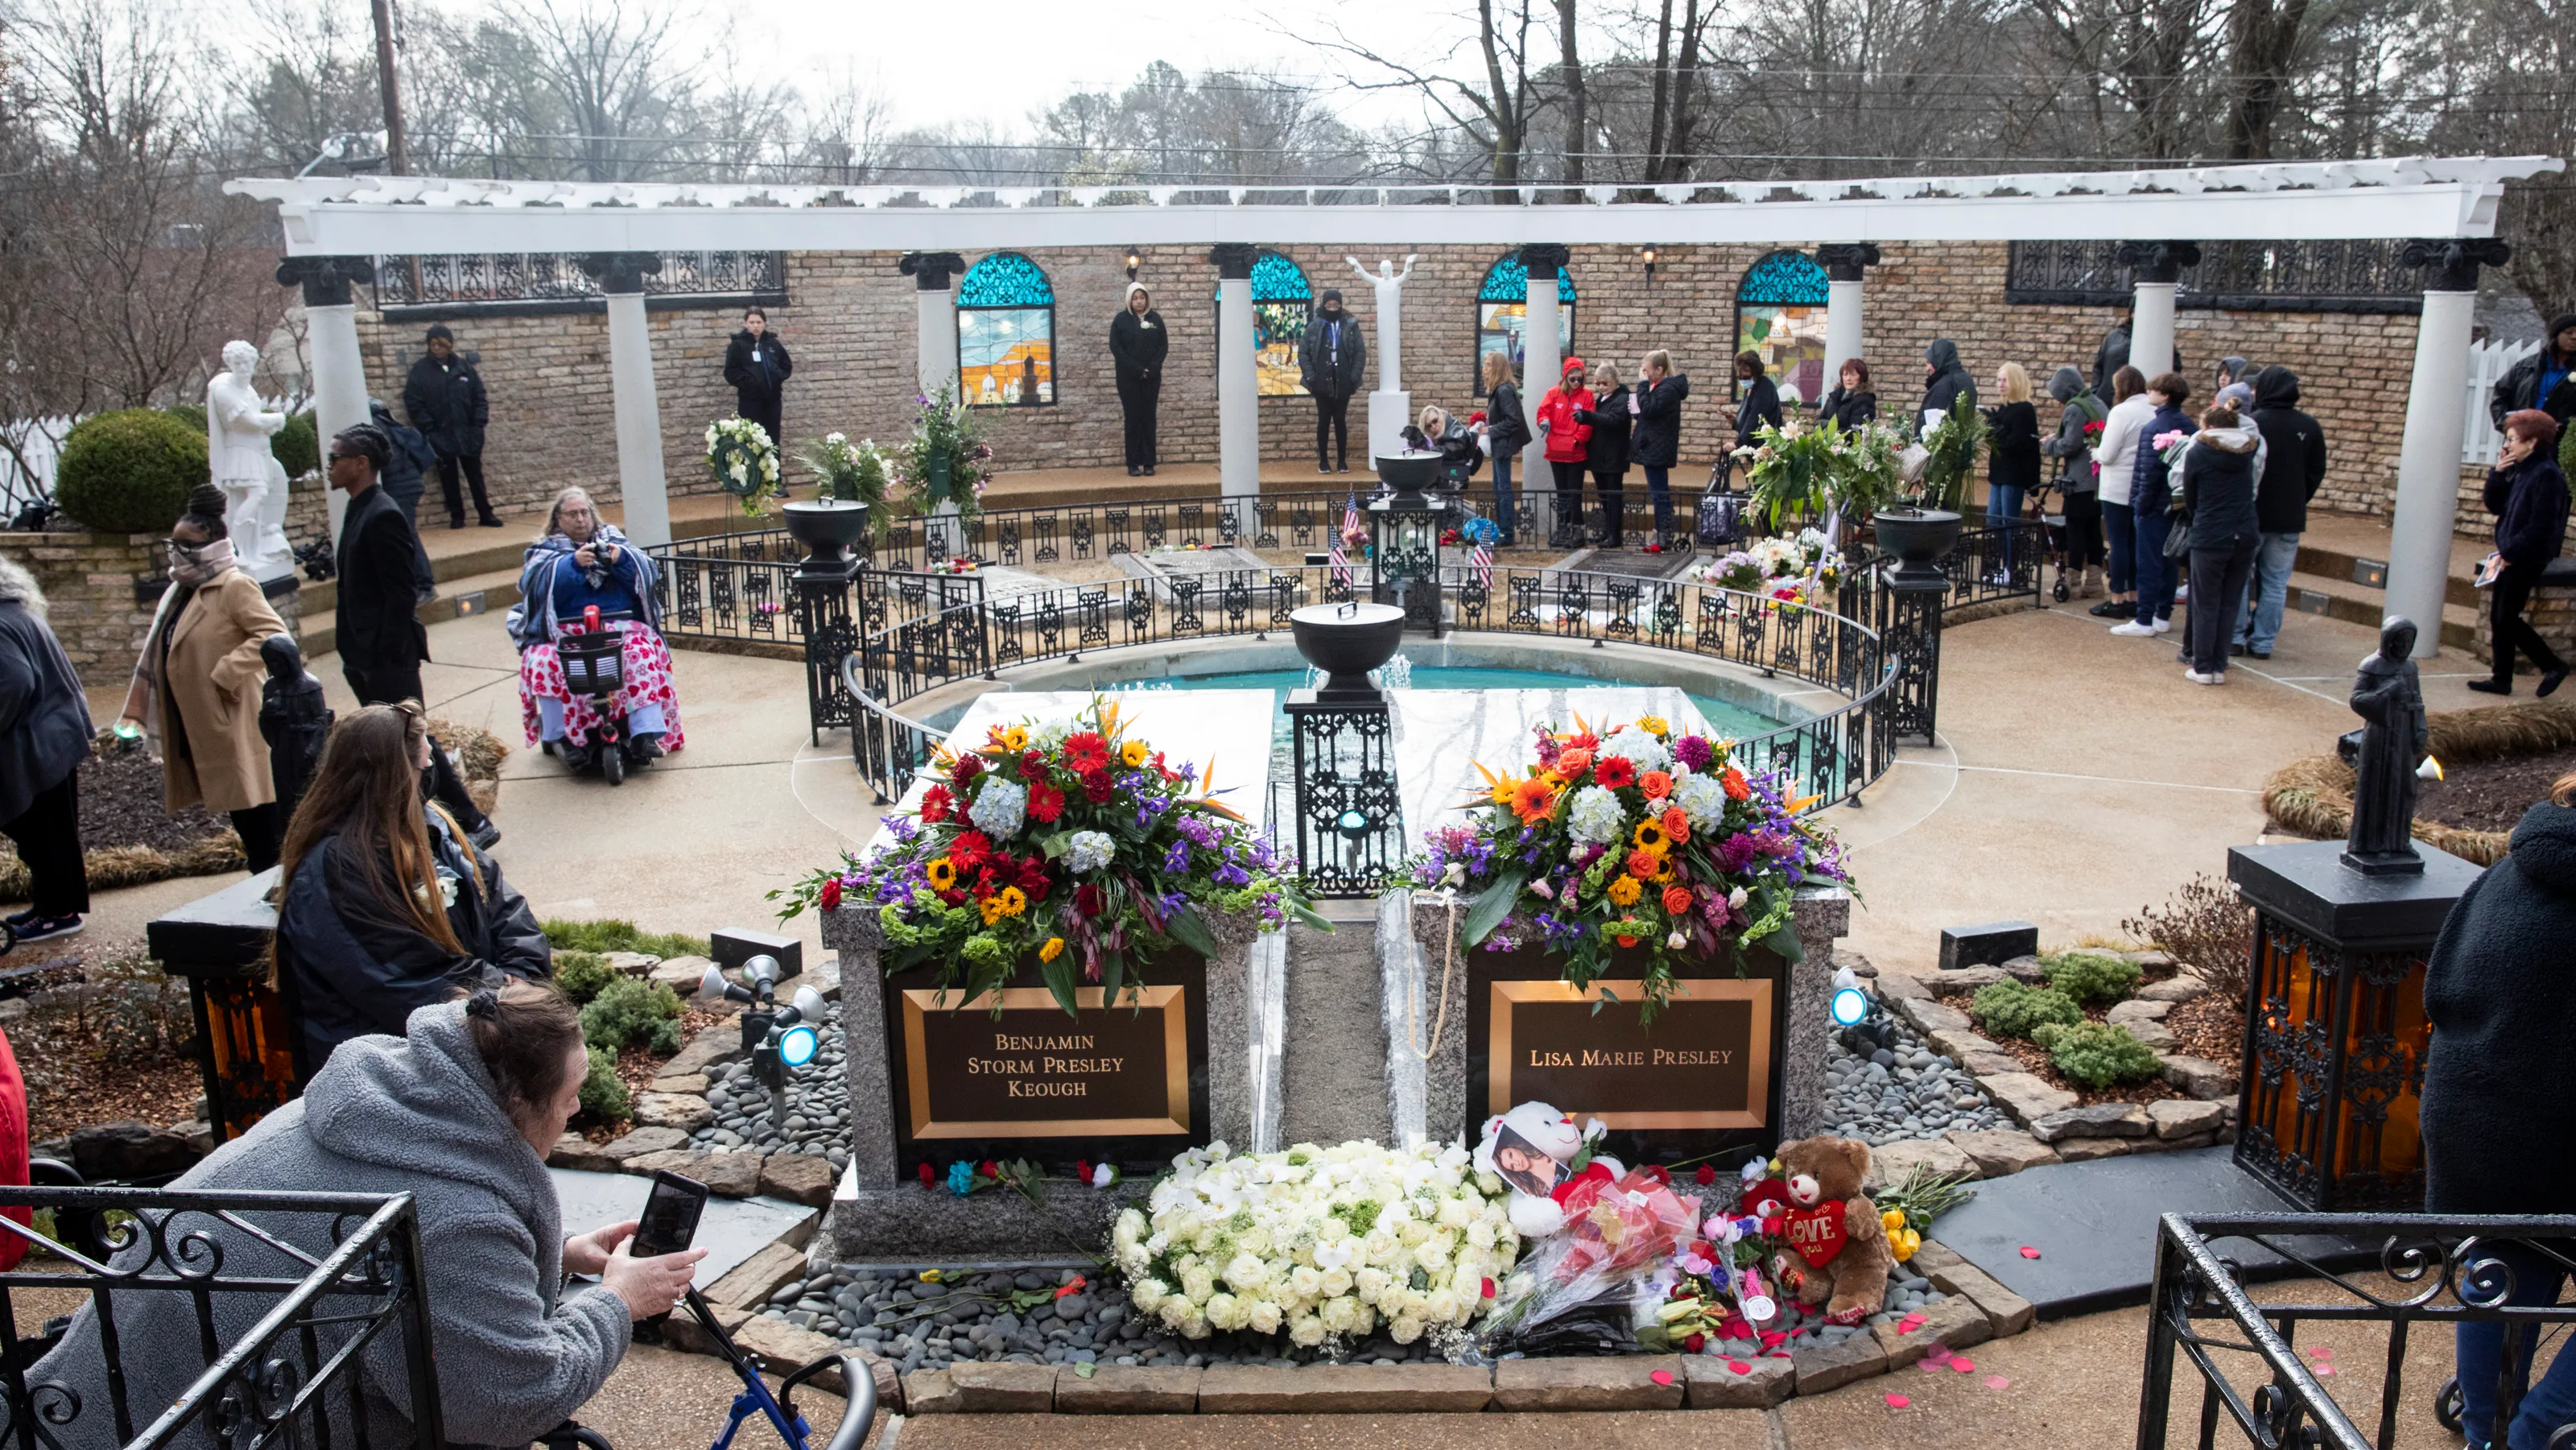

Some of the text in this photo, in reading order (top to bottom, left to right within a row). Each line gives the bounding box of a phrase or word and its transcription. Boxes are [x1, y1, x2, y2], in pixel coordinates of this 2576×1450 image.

[995, 1033, 1095, 1051] BENJAMIN
[968, 1056, 1124, 1074] STORM PRESLEY
[1530, 1048, 1732, 1067] LISA MARIE PRESLEY
[1008, 1080, 1087, 1097] KEOUGH
[1786, 1208, 1794, 1220] I
[1783, 1216, 1835, 1244] LOVE
